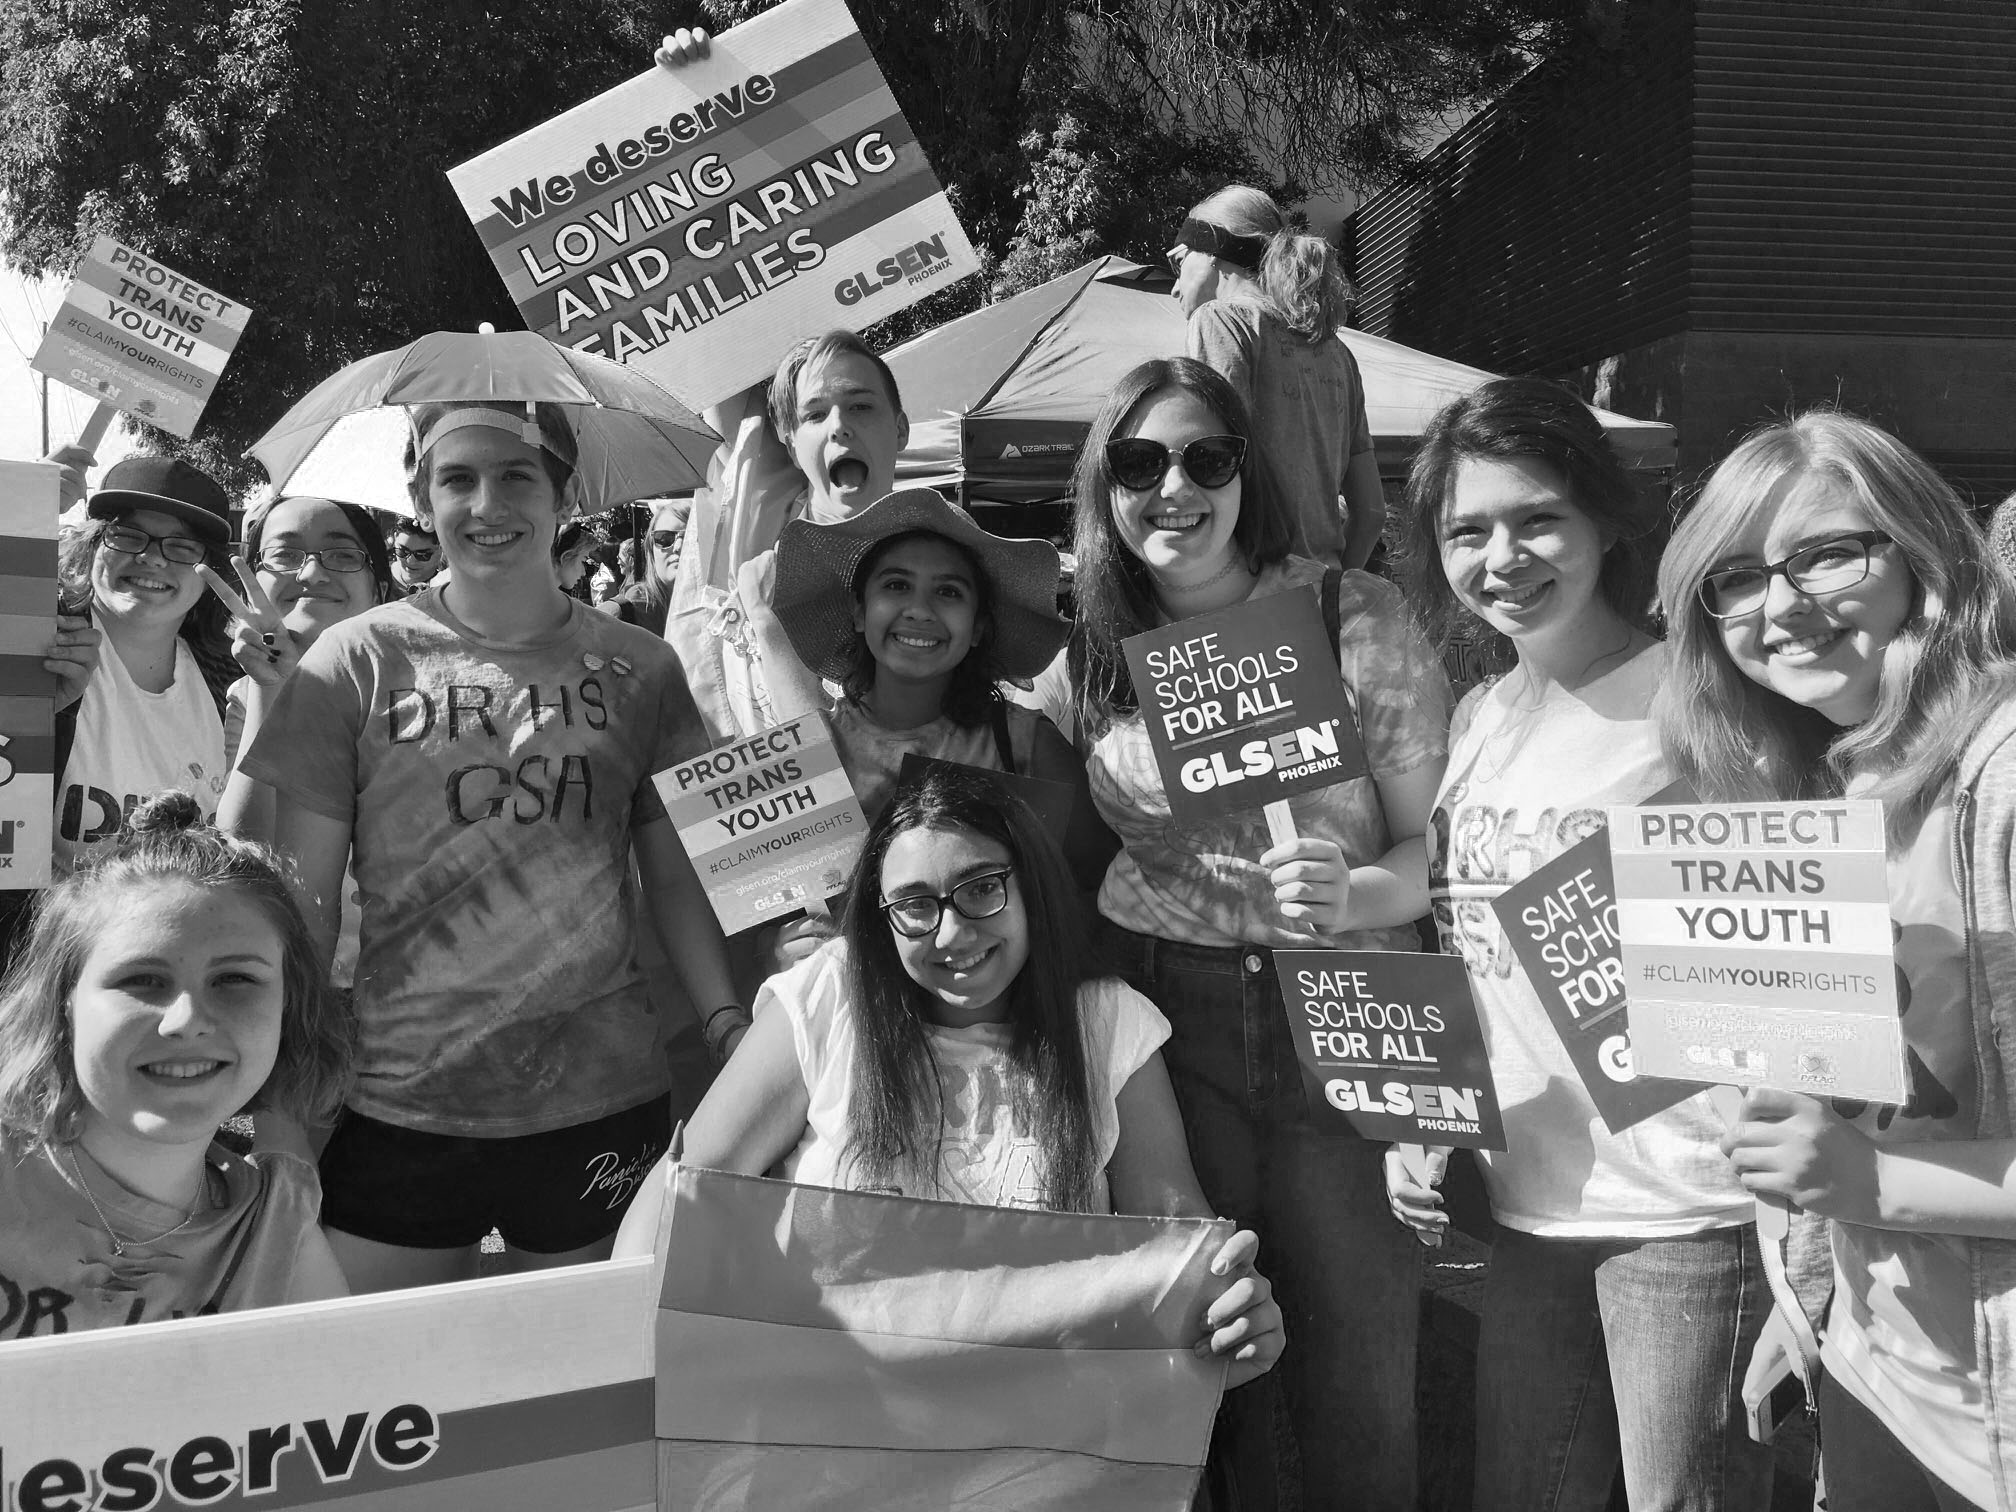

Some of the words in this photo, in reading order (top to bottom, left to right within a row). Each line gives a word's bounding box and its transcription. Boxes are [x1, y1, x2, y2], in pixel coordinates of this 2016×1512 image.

[492, 174, 575, 228] We
[584, 73, 776, 185] deserve
[519, 154, 735, 287] LOVING
[556, 247, 671, 333] AND
[684, 132, 897, 261] CARING
[110, 247, 232, 318] PROTECT
[907, 259, 953, 286] PHOENIX
[107, 300, 196, 357] YOUTH
[119, 278, 206, 334] TRANS
[67, 318, 204, 388] #CLAIMYOURRIGHTS
[1146, 633, 1225, 679] SAFE
[1155, 645, 1299, 709] SCHOOLS
[389, 677, 607, 744] DRHS
[1162, 700, 1227, 742] FOR
[1237, 682, 1294, 721] ALL
[675, 723, 802, 790] PROTECT
[704, 759, 802, 809] TRANS
[1278, 756, 1342, 782] PHOENIX
[446, 755, 593, 825] GSA
[718, 785, 817, 837] YOUTH
[709, 811, 853, 875] #CLAIMYOURRIGHTS
[1640, 808, 1847, 846] PROTECT
[1522, 869, 1609, 941] SAFE
[1671, 859, 1826, 894] TRANS
[1541, 905, 1622, 979] SCHO
[1675, 907, 1832, 944] YOUTH
[1297, 970, 1373, 999] SAFE
[1559, 956, 1625, 1018] FOR
[1643, 964, 1877, 995] #CLAIMYOURRIGHTS
[1304, 1001, 1445, 1033] SCHOOLS
[1310, 1031, 1372, 1059] FOR
[1382, 1034, 1438, 1063] ALL
[1418, 1118, 1481, 1134] PHOENIX
[0, 1402, 438, 1512] eserve
